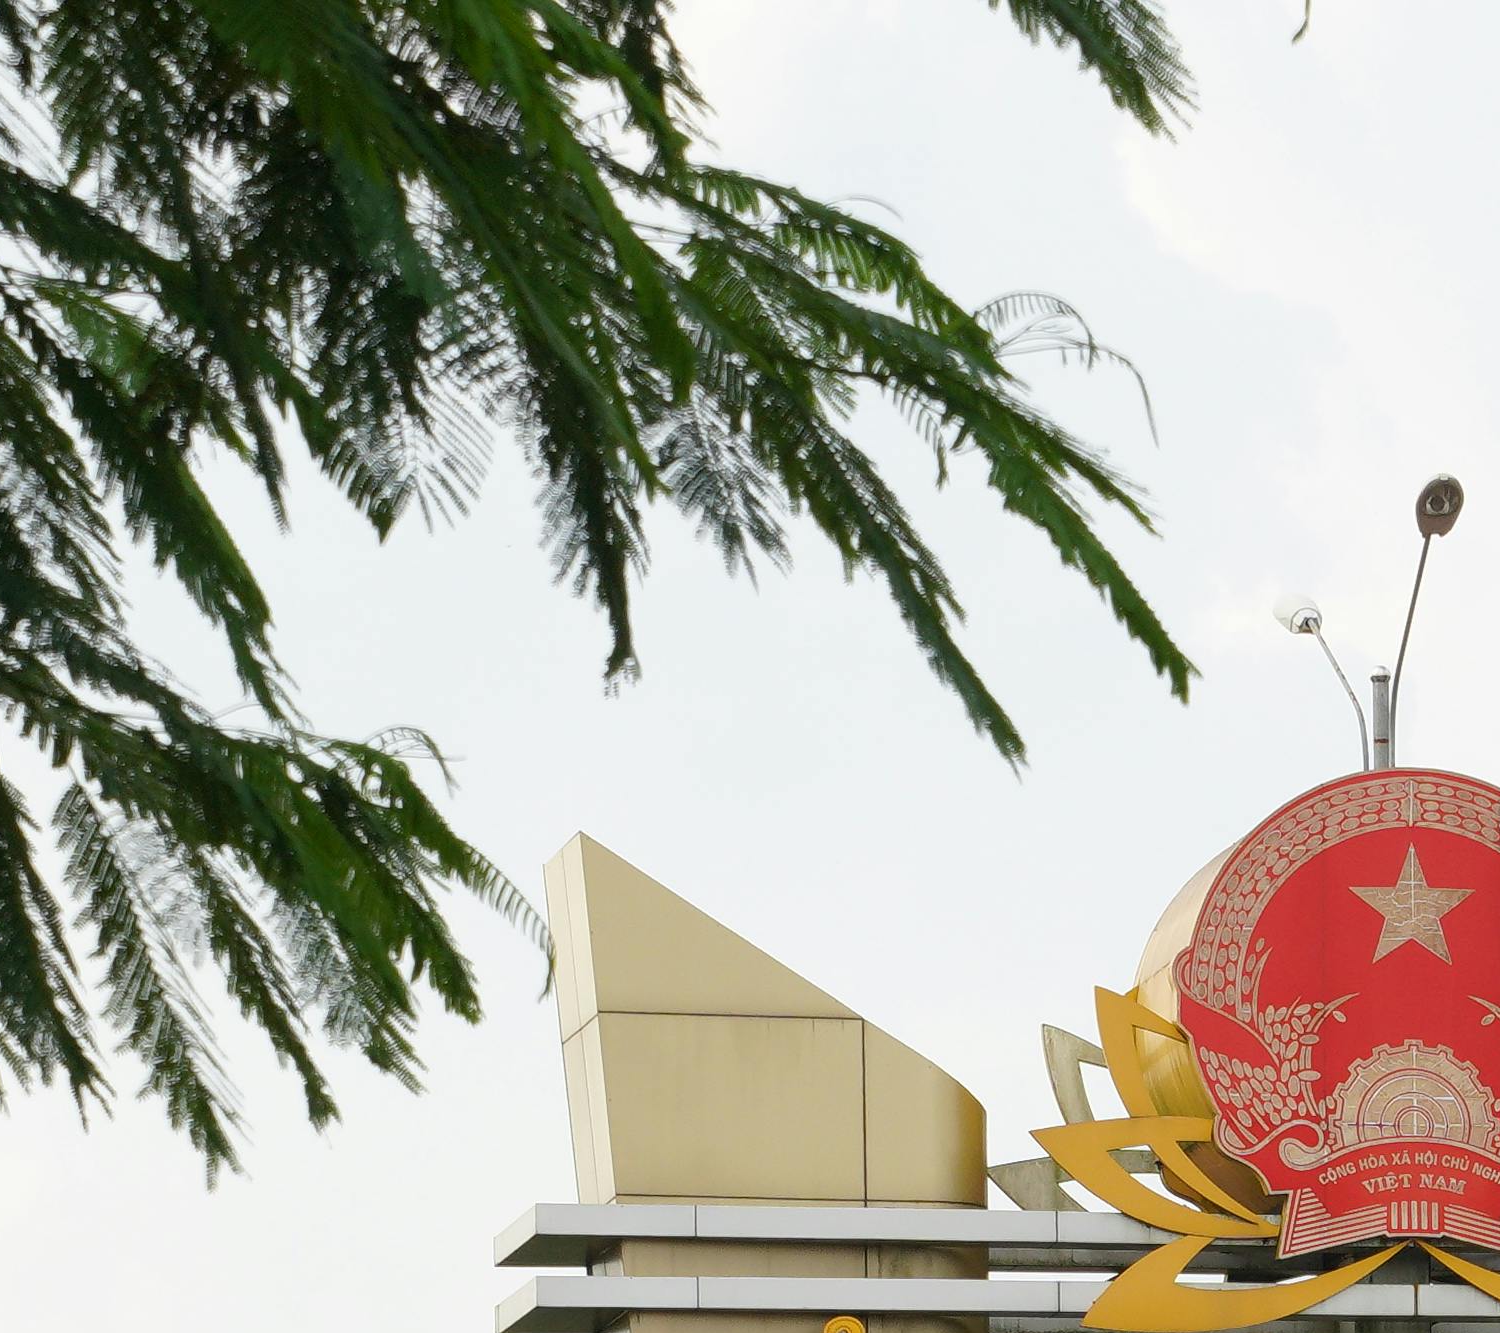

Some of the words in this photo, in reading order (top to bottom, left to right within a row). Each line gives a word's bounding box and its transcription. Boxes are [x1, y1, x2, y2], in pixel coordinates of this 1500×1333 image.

[1318, 1163, 1357, 1185] CỘNG
[1359, 1153, 1388, 1171] HÒA
[1391, 1150, 1411, 1165] XÃ
[1414, 1150, 1438, 1169] HỘI
[1441, 1153, 1470, 1171] CHỦ
[1361, 1172, 1413, 1194] VIỆT
[1419, 1173, 1468, 1195] NAM
